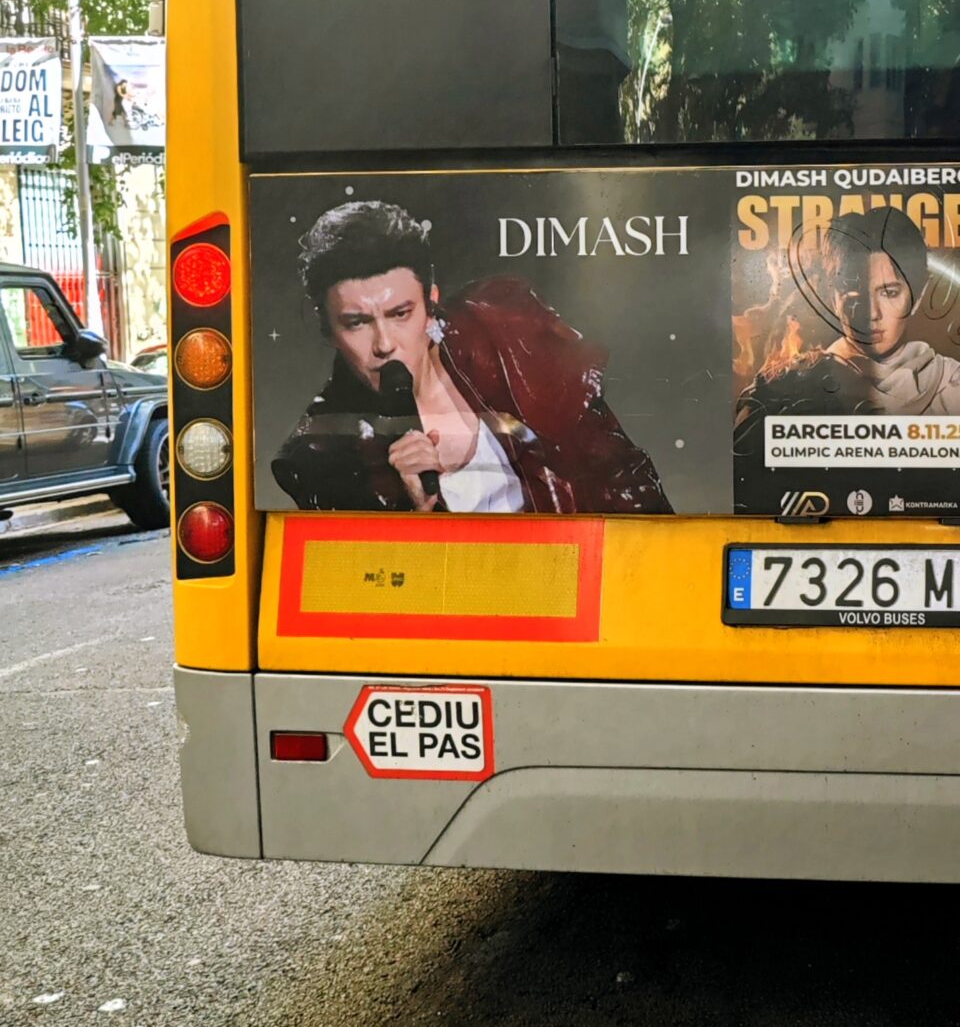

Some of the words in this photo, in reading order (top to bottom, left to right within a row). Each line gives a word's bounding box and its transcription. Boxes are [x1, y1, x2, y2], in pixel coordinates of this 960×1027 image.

[0, 68, 47, 92] DOM
[28, 94, 54, 117] AL
[736, 169, 827, 187] DIMASH
[498, 216, 689, 257] DIMASH
[771, 424, 903, 440] BARCELONA
[771, 446, 830, 458] OLIMPIC
[835, 447, 884, 458] ARENA
[733, 587, 745, 601] E
[763, 557, 900, 608] 7326
[838, 612, 880, 624] VOLVO
[884, 613, 926, 625] BUSES
[367, 699, 480, 729] CEDIU
[368, 731, 408, 758] EL
[419, 733, 481, 759] PAS
